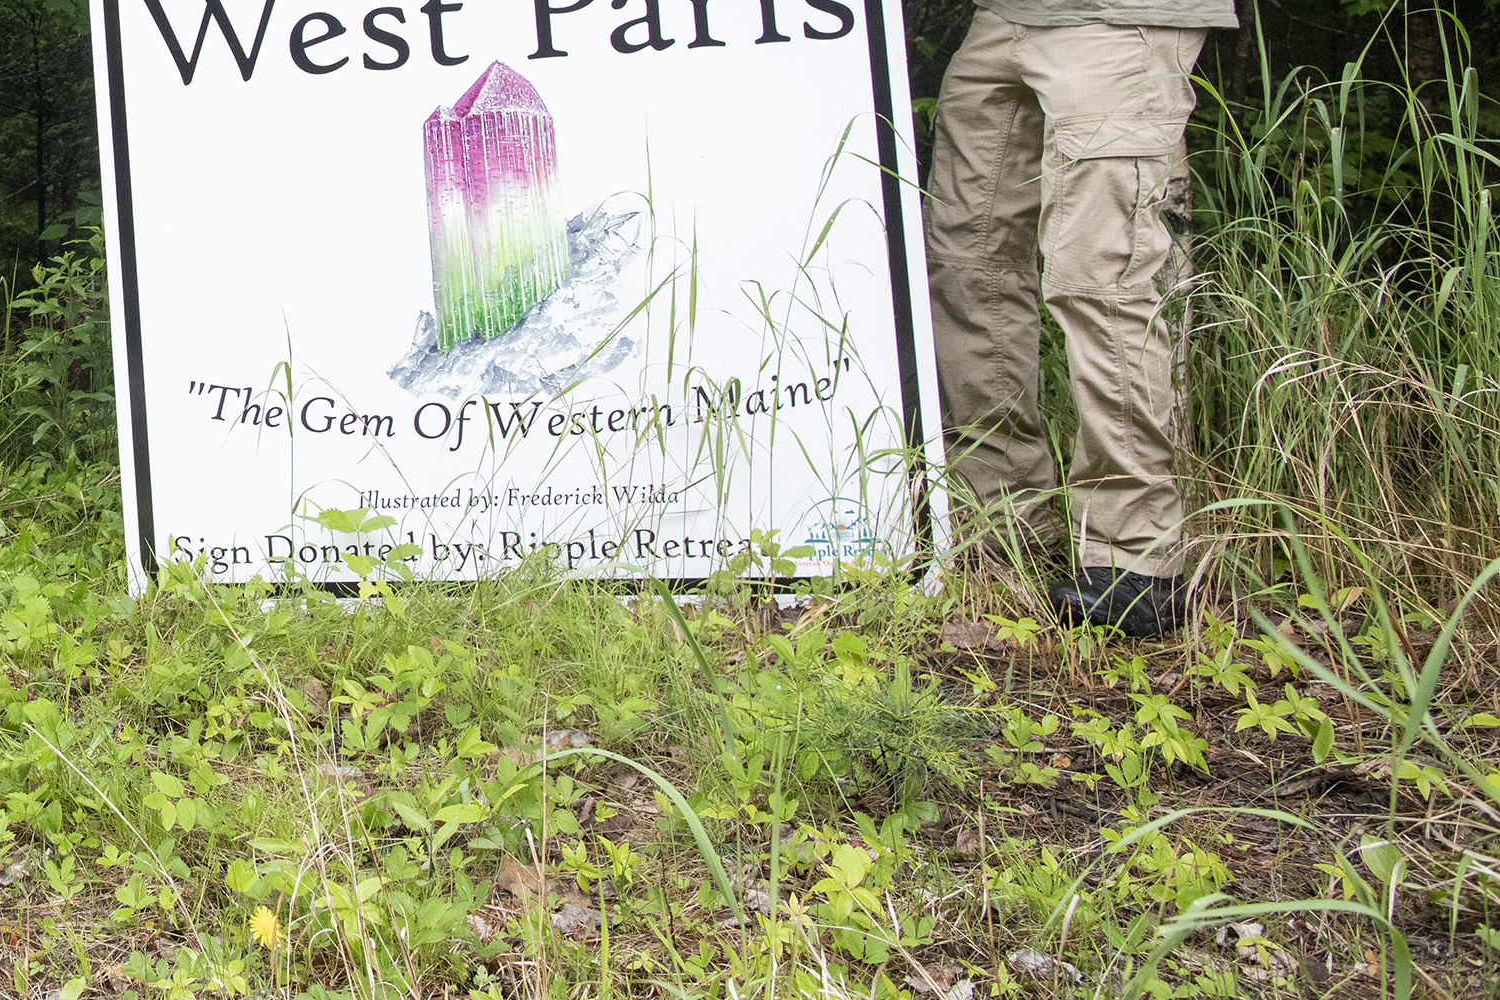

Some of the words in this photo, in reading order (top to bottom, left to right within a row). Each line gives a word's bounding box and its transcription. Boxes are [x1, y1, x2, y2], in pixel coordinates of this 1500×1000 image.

[188, 381, 284, 428] "The
[300, 396, 396, 438] Gem
[413, 400, 477, 452] Of
[488, 401, 676, 439] Western
[358, 488, 462, 510] Illustrated
[468, 489, 500, 513] by:
[507, 483, 604, 505] Frederick
[611, 483, 680, 504] Wilda
[175, 536, 253, 574] Sign
[429, 532, 485, 572] by:
[635, 528, 771, 559] Retrea
